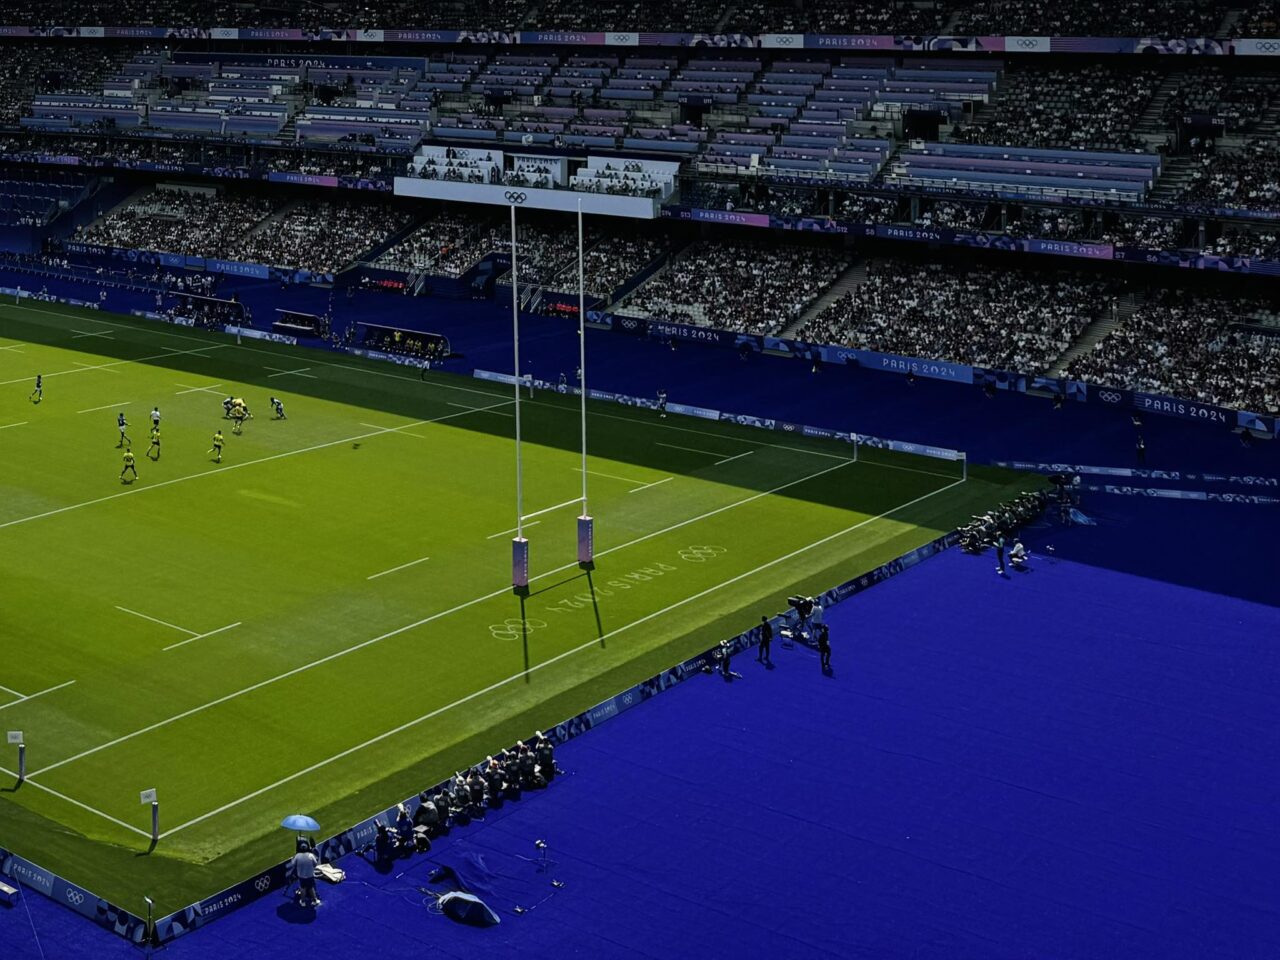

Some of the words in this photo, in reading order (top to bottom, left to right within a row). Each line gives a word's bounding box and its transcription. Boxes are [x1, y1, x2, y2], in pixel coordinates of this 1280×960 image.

[819, 38, 848, 47] PARIS
[850, 38, 878, 47] 2024
[699, 212, 722, 220] PARIS
[725, 214, 746, 222] 2024
[888, 228, 913, 238] PARIS
[915, 231, 940, 240] 2024
[1040, 242, 1071, 252] PARIS
[1073, 245, 1100, 255] 2024
[883, 359, 918, 371] PARIS
[922, 364, 956, 378] 2024
[1145, 398, 1185, 414] PARIS
[1190, 407, 1226, 424] 2024
[608, 562, 678, 590] PARIS
[545, 585, 614, 614] 2024
[13, 863, 32, 878] PARIS
[32, 874, 50, 888] 2024
[204, 902, 224, 915] PARIS
[224, 893, 242, 906] 2024
